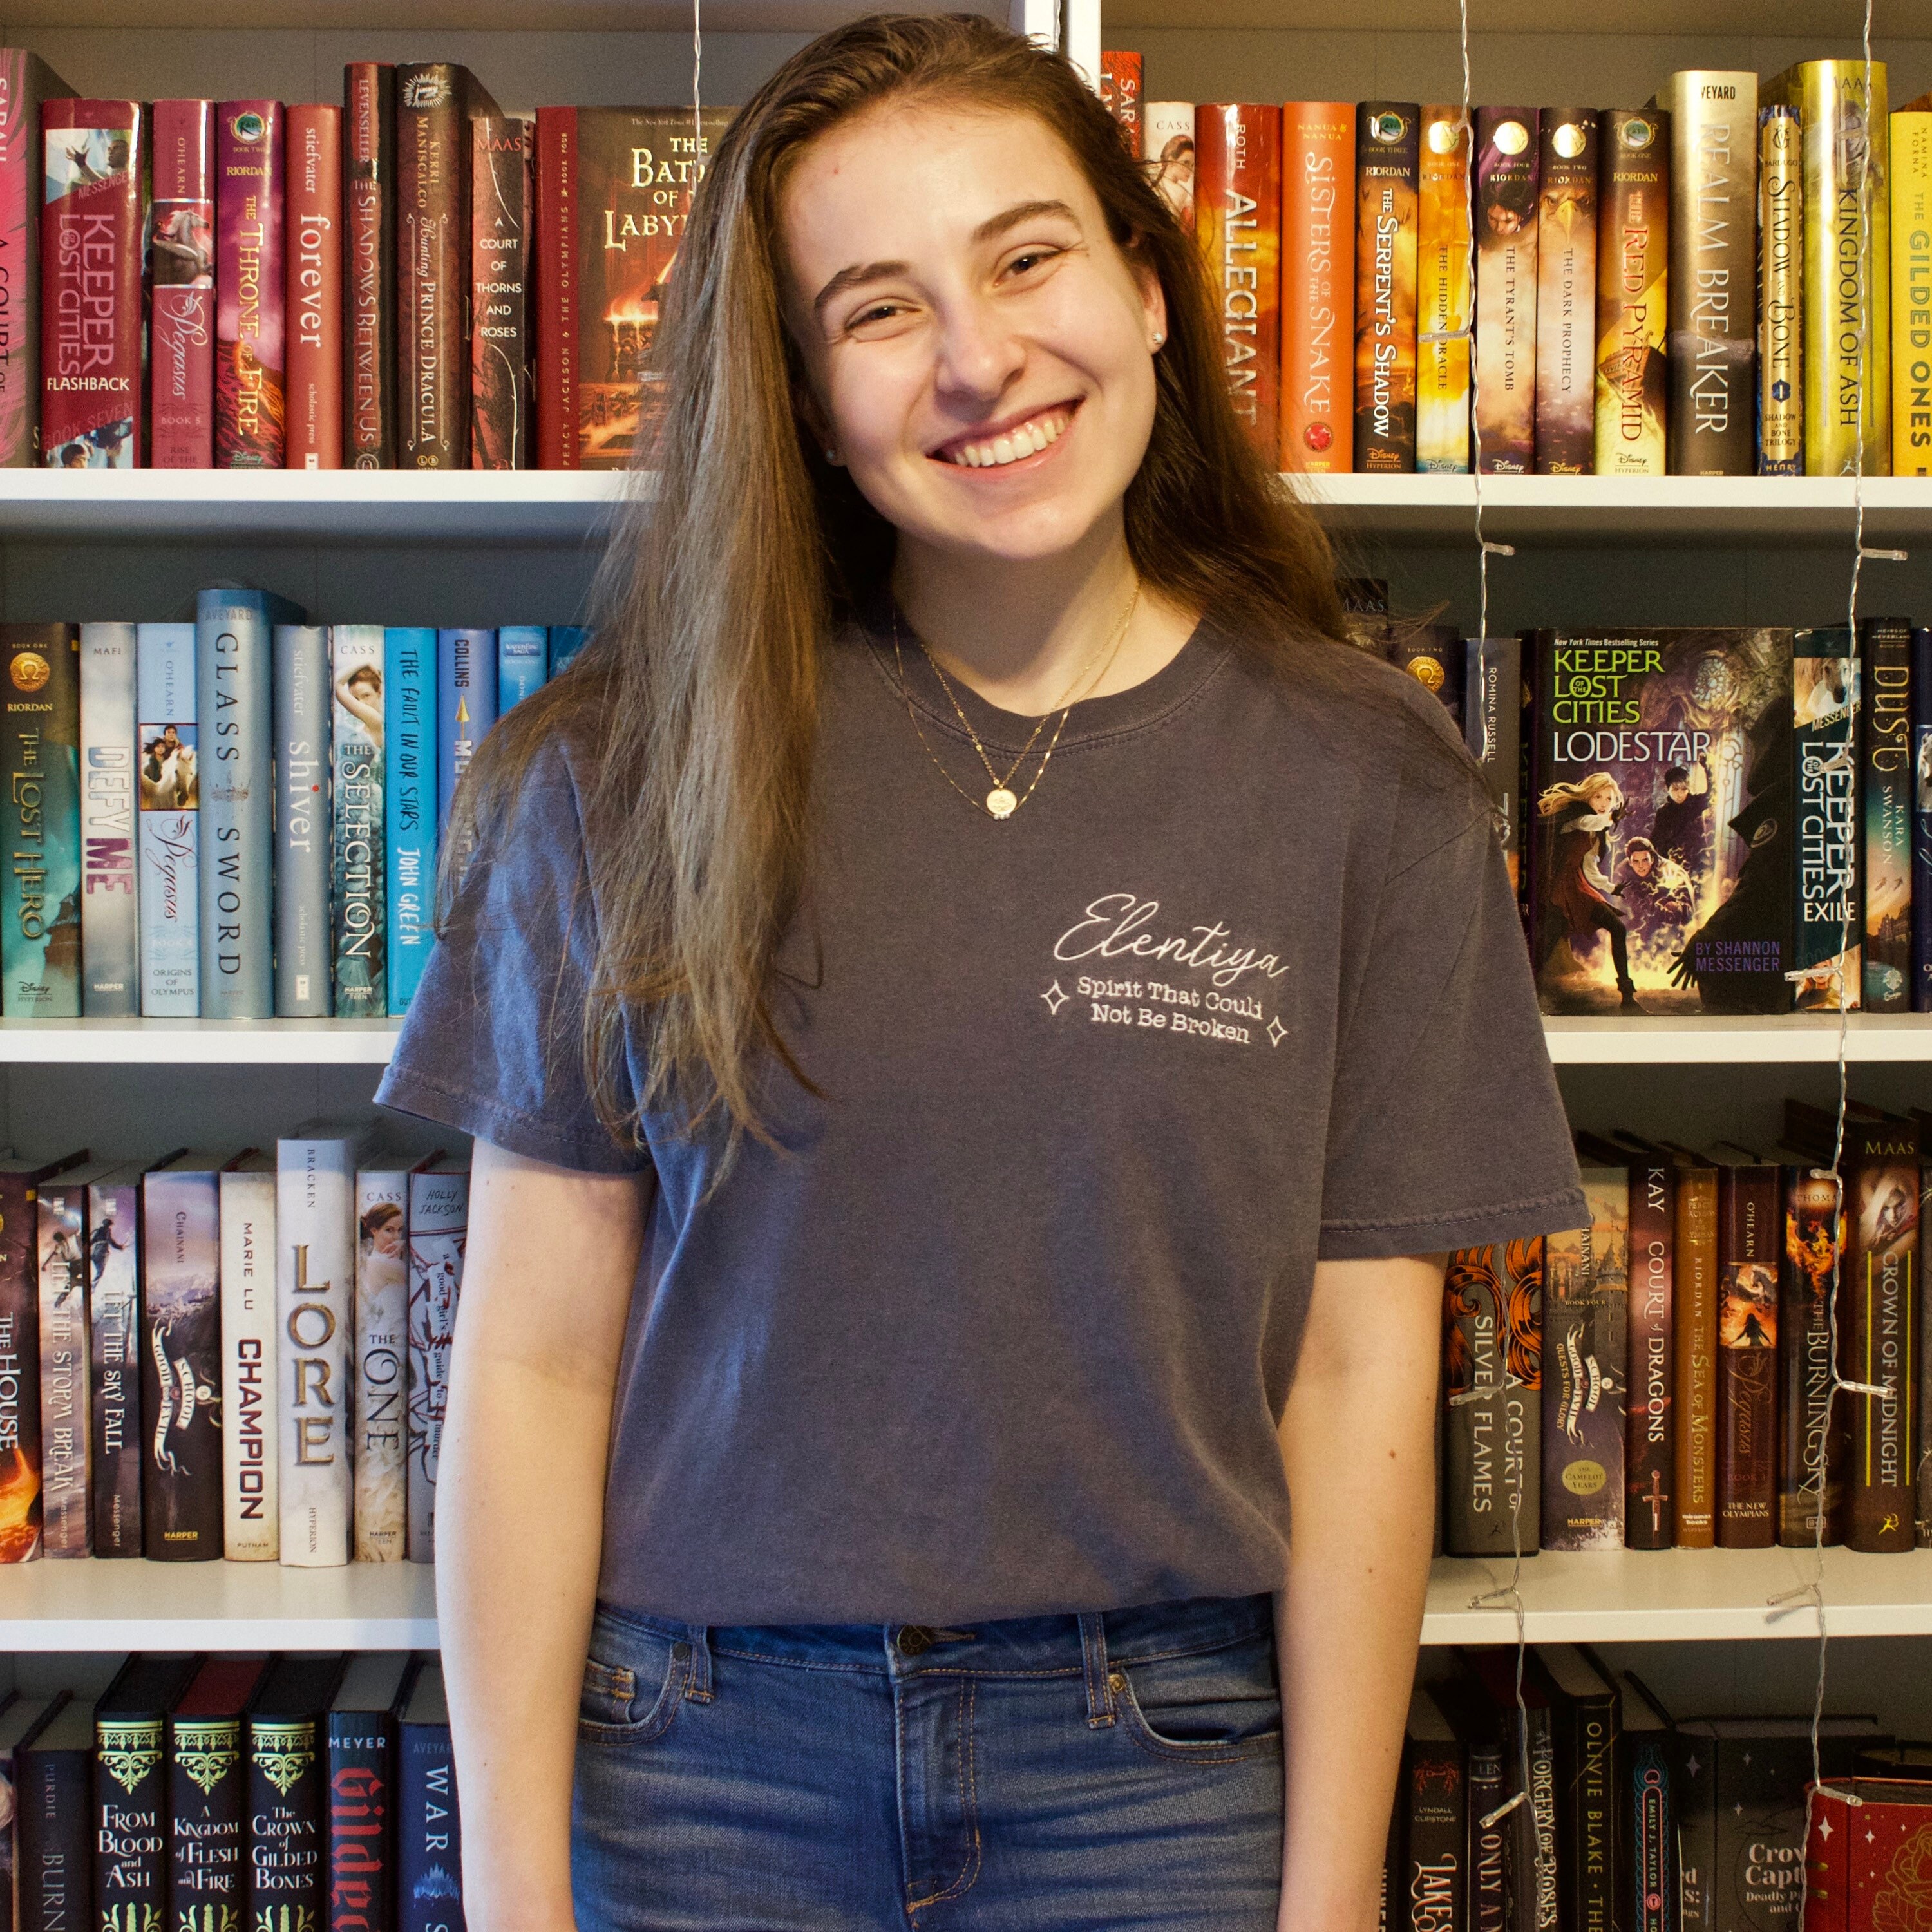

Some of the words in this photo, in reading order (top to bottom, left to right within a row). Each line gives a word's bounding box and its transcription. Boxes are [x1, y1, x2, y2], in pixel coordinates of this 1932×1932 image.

[359, 79, 370, 162] LEVENSELLER
[306, 127, 321, 194] stiefvater
[417, 116, 427, 208] MANISCALCO
[1366, 166, 1410, 176] RIORDAN
[247, 196, 256, 220] THE
[1382, 189, 1392, 213] THE
[1697, 125, 1729, 249] REALM
[1915, 193, 1924, 221] THE
[59, 214, 79, 283] LOST
[420, 217, 437, 278] Hunting
[480, 239, 518, 249] COURT
[1767, 176, 1795, 277] SHADOW
[358, 194, 376, 307] SHADOWS
[491, 261, 507, 270] OF
[1506, 247, 1515, 273] THE
[1563, 248, 1573, 275] THE
[1623, 226, 1649, 293] RED
[1839, 187, 1857, 325] KINGDOM
[82, 214, 114, 372] KEEPER
[240, 223, 263, 339] THRONE
[301, 213, 330, 348] forever
[476, 283, 522, 293] THORNS
[1376, 216, 1397, 336] SERPENT'S
[1562, 280, 1573, 317] DARK
[1909, 229, 1930, 348] GILDED
[422, 281, 436, 350] PRINCE
[487, 305, 511, 316] AND
[1224, 190, 1257, 424] ALLEGIANT
[1505, 278, 1515, 345] TYRANT'S
[58, 290, 79, 375] CITIES
[157, 295, 207, 400] Pegasus
[243, 345, 252, 360] OF
[480, 327, 516, 337] ROSES
[1690, 269, 1729, 434] BREAKER
[1767, 298, 1795, 369] BONE
[1839, 332, 1857, 365] OF
[358, 312, 376, 412] BETWEEN
[1303, 308, 1336, 413] SNAKE
[1504, 351, 1515, 391] TOMB
[1561, 323, 1572, 393] PROPHECY
[1621, 302, 1654, 441] PYRAMID
[48, 377, 129, 390] FLASHBACK
[238, 367, 262, 435] FIRE
[422, 355, 437, 443] DRACULA
[1374, 343, 1396, 437] SHADOW
[1839, 375, 1857, 426] ASH
[1910, 361, 1930, 448] ONES
[360, 418, 374, 442] US
[341, 645, 374, 654] CASS
[400, 649, 417, 676] THE
[454, 639, 469, 688] COLLINS
[1554, 649, 1664, 673] KEEPER
[8, 703, 53, 712] RIORDAN
[216, 632, 240, 761] GLASS
[400, 687, 420, 728] FAULT
[1488, 667, 1497, 712] ROMINA
[1554, 676, 1628, 698] LOST
[1553, 701, 1640, 723] CITIES
[1873, 666, 1910, 771] DUST
[18, 729, 39, 768] THE
[345, 745, 371, 755] THE
[401, 735, 418, 750] IN
[1487, 717, 1496, 762] RUSSELL
[1554, 732, 1710, 762] LODESTAR
[399, 752, 418, 777] OUR
[1802, 742, 1824, 809] LOST
[13, 772, 43, 846] LOST
[88, 746, 130, 836] DEFY
[289, 741, 320, 853] shiver
[400, 786, 418, 830] STARS
[86, 838, 132, 894] ME
[146, 814, 198, 922] Pegasus
[343, 761, 371, 957] SELECTION
[397, 848, 421, 886] JOHN
[1802, 815, 1824, 899] CITIES
[13, 851, 46, 940] HERO
[218, 827, 242, 974] SWORD
[397, 891, 421, 945] GREEN
[1804, 902, 1855, 922] EXILE
[1054, 893, 1289, 987] Elentiya
[1696, 942, 1711, 956] BY
[1716, 941, 1779, 955] SHANNON
[1696, 958, 1779, 971] MESSENGER
[1077, 977, 1142, 998] Spirit
[1148, 982, 1200, 1006] That
[1206, 992, 1264, 1019] Could
[1091, 1003, 1132, 1025] Not
[1137, 1009, 1166, 1028] Be
[1170, 1012, 1250, 1043] Broken
[1865, 1142, 1915, 1155] MAAS
[368, 1192, 401, 1202] CASS
[1648, 1168, 1664, 1213] KAY
[243, 1223, 252, 1277] MARIE
[1746, 1202, 1754, 1257] O'HEARN
[243, 1288, 252, 1310] LU
[1645, 1242, 1664, 1319] COURT
[104, 1333, 123, 1367] THE
[287, 1244, 336, 1467] LORE
[370, 1335, 395, 1343] THE
[1557, 1344, 1568, 1377] QUESTS
[104, 1370, 123, 1401] SKY
[1648, 1338, 1664, 1442] DRAGONS
[1692, 1354, 1710, 1389] SEA
[0, 1354, 17, 1452] HOUSE
[363, 1348, 399, 1449] ONE
[1557, 1399, 1568, 1430] GLORY
[104, 1408, 123, 1454] FALL
[238, 1339, 263, 1519] CHAMPION
[1474, 1413, 1492, 1512] FLAMES
[1692, 1415, 1709, 1503] MONSTERS
[329, 1738, 385, 1748] MEYER
[1587, 1722, 1602, 1797] OLIVIE
[102, 1804, 155, 1832] FROM
[252, 1815, 316, 1835] CROWN
[272, 1807, 295, 1818] The
[426, 1765, 448, 1852] WAR
[98, 1830, 162, 1857] BLOOD
[121, 1857, 141, 1868] and
[252, 1846, 317, 1867] GILDED
[279, 1836, 289, 1852] of
[1587, 1812, 1602, 1874] BLAKE
[106, 1865, 150, 1888] ASH
[256, 1869, 314, 1889] BONES
